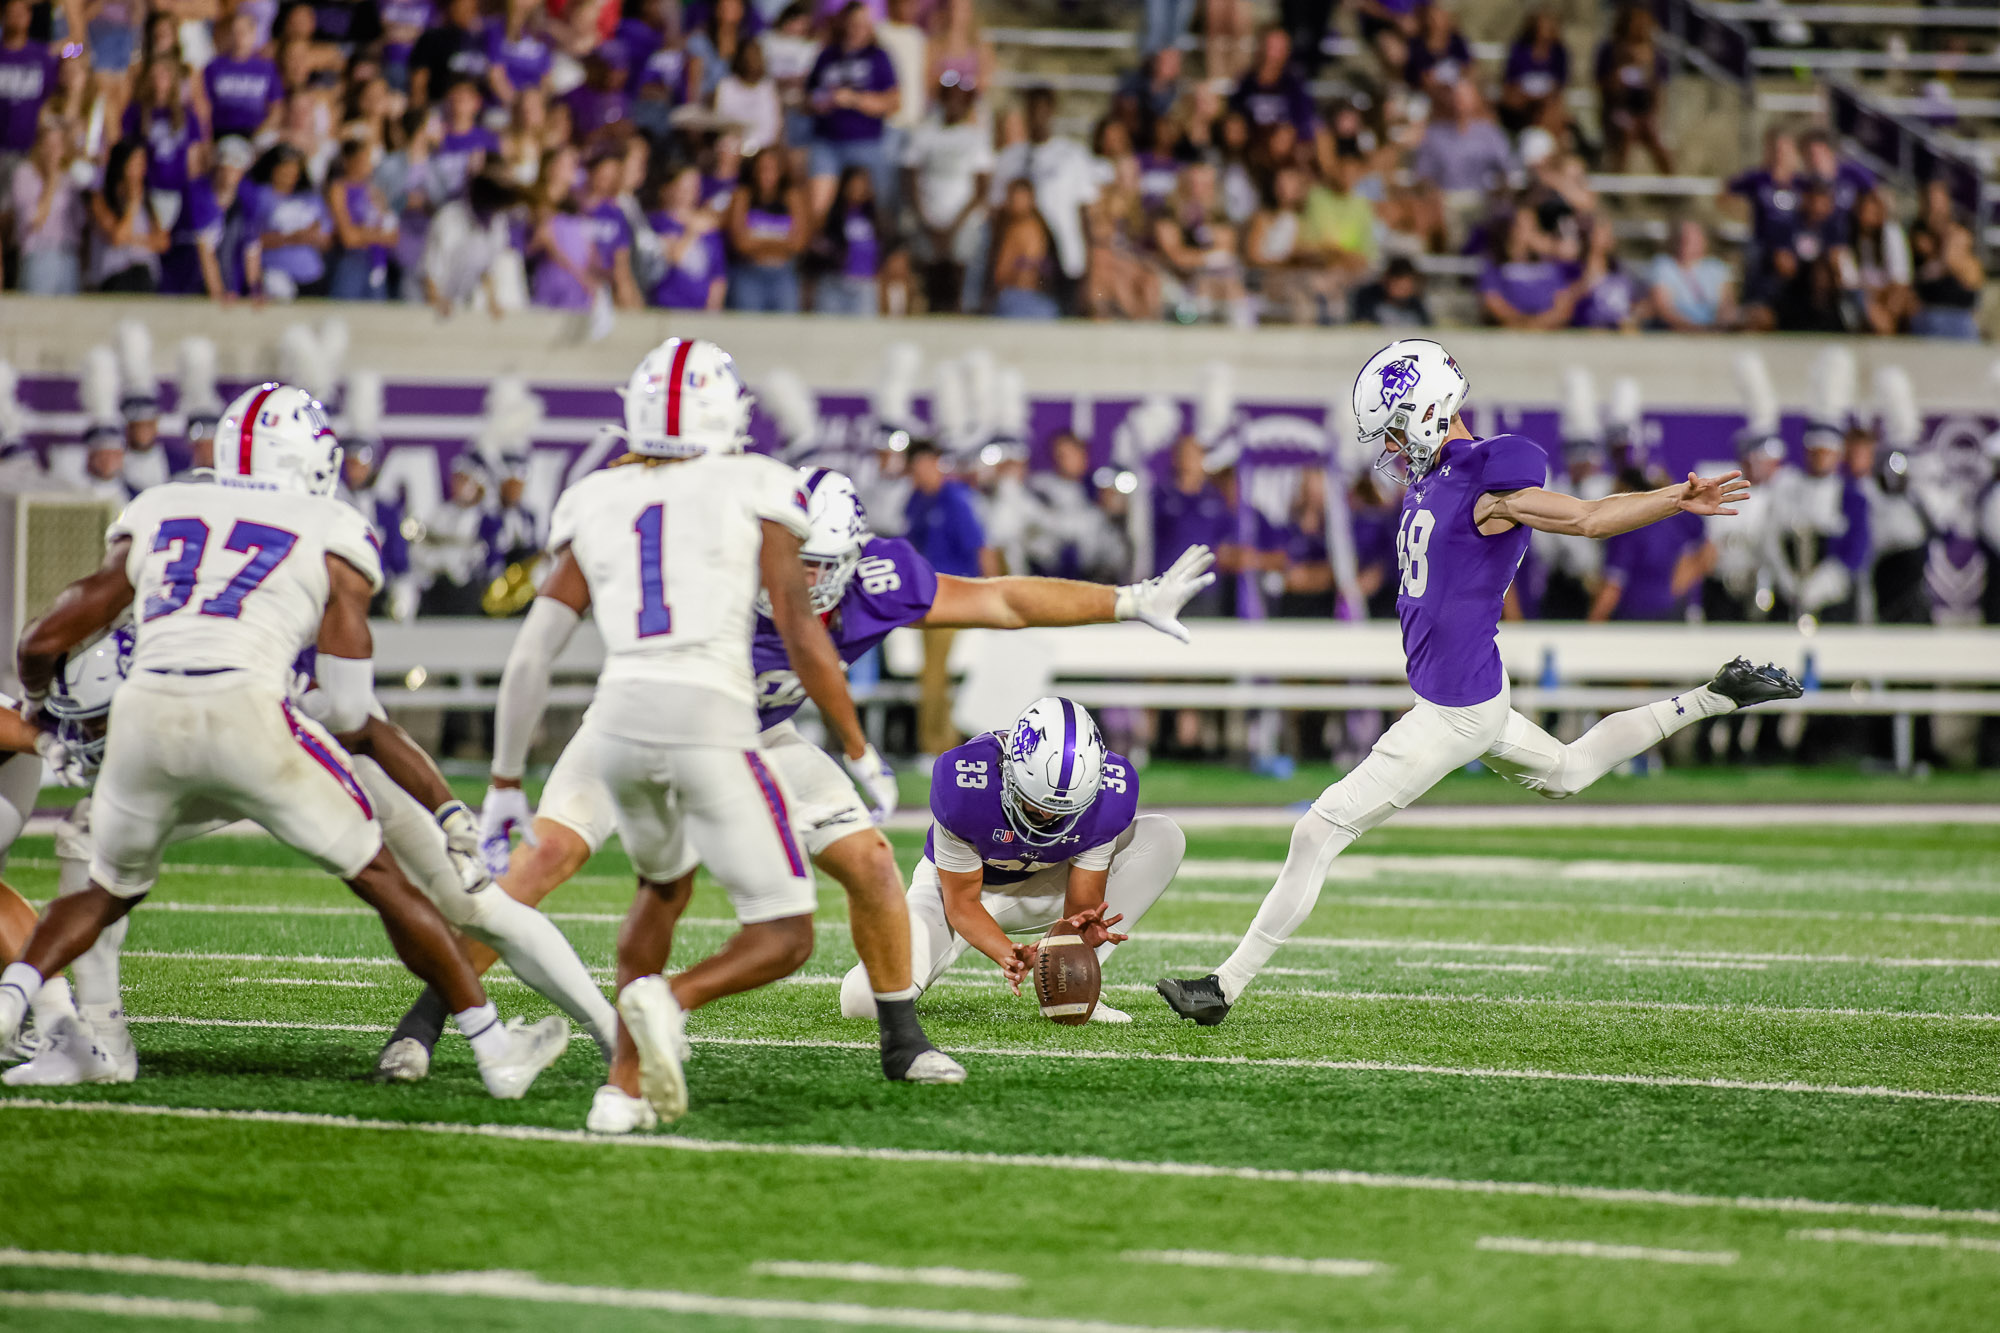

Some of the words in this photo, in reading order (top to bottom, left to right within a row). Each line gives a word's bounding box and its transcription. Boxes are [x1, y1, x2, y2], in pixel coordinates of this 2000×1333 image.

[1380, 360, 1421, 411] ACU
[143, 516, 300, 622] 37
[633, 503, 671, 638] 1
[857, 557, 901, 595] 90
[955, 759, 988, 789] 33
[1100, 762, 1127, 794] 33
[1056, 956, 1067, 993] Wilson
